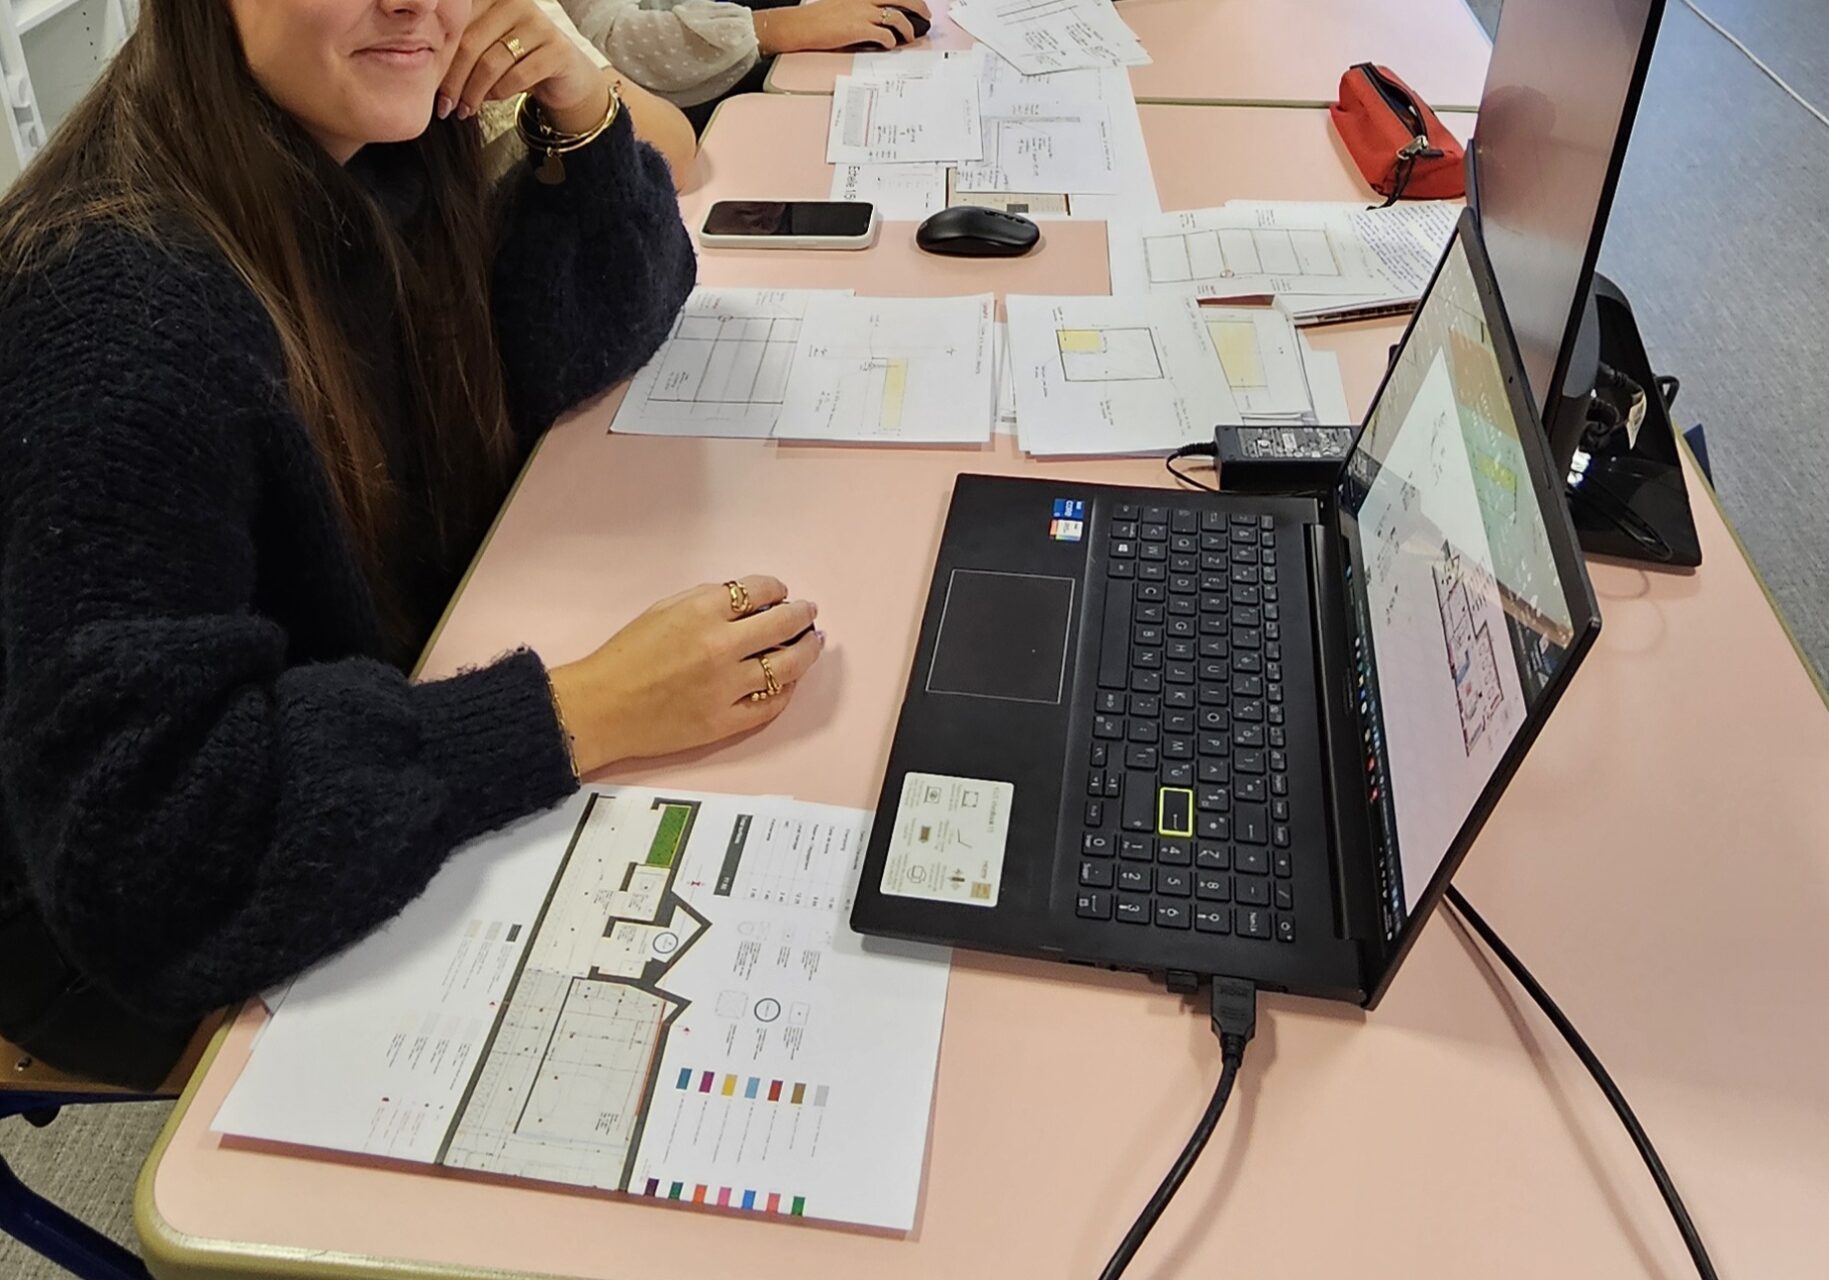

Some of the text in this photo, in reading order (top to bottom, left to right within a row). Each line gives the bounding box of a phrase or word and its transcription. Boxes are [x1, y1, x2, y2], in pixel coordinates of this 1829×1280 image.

[1179, 539, 1189, 547] Q
[1149, 546, 1158, 554] W
[1176, 622, 1187, 630] G
[1207, 713, 1219, 722] O
[1173, 742, 1183, 750] M
[1093, 838, 1105, 846] 0
